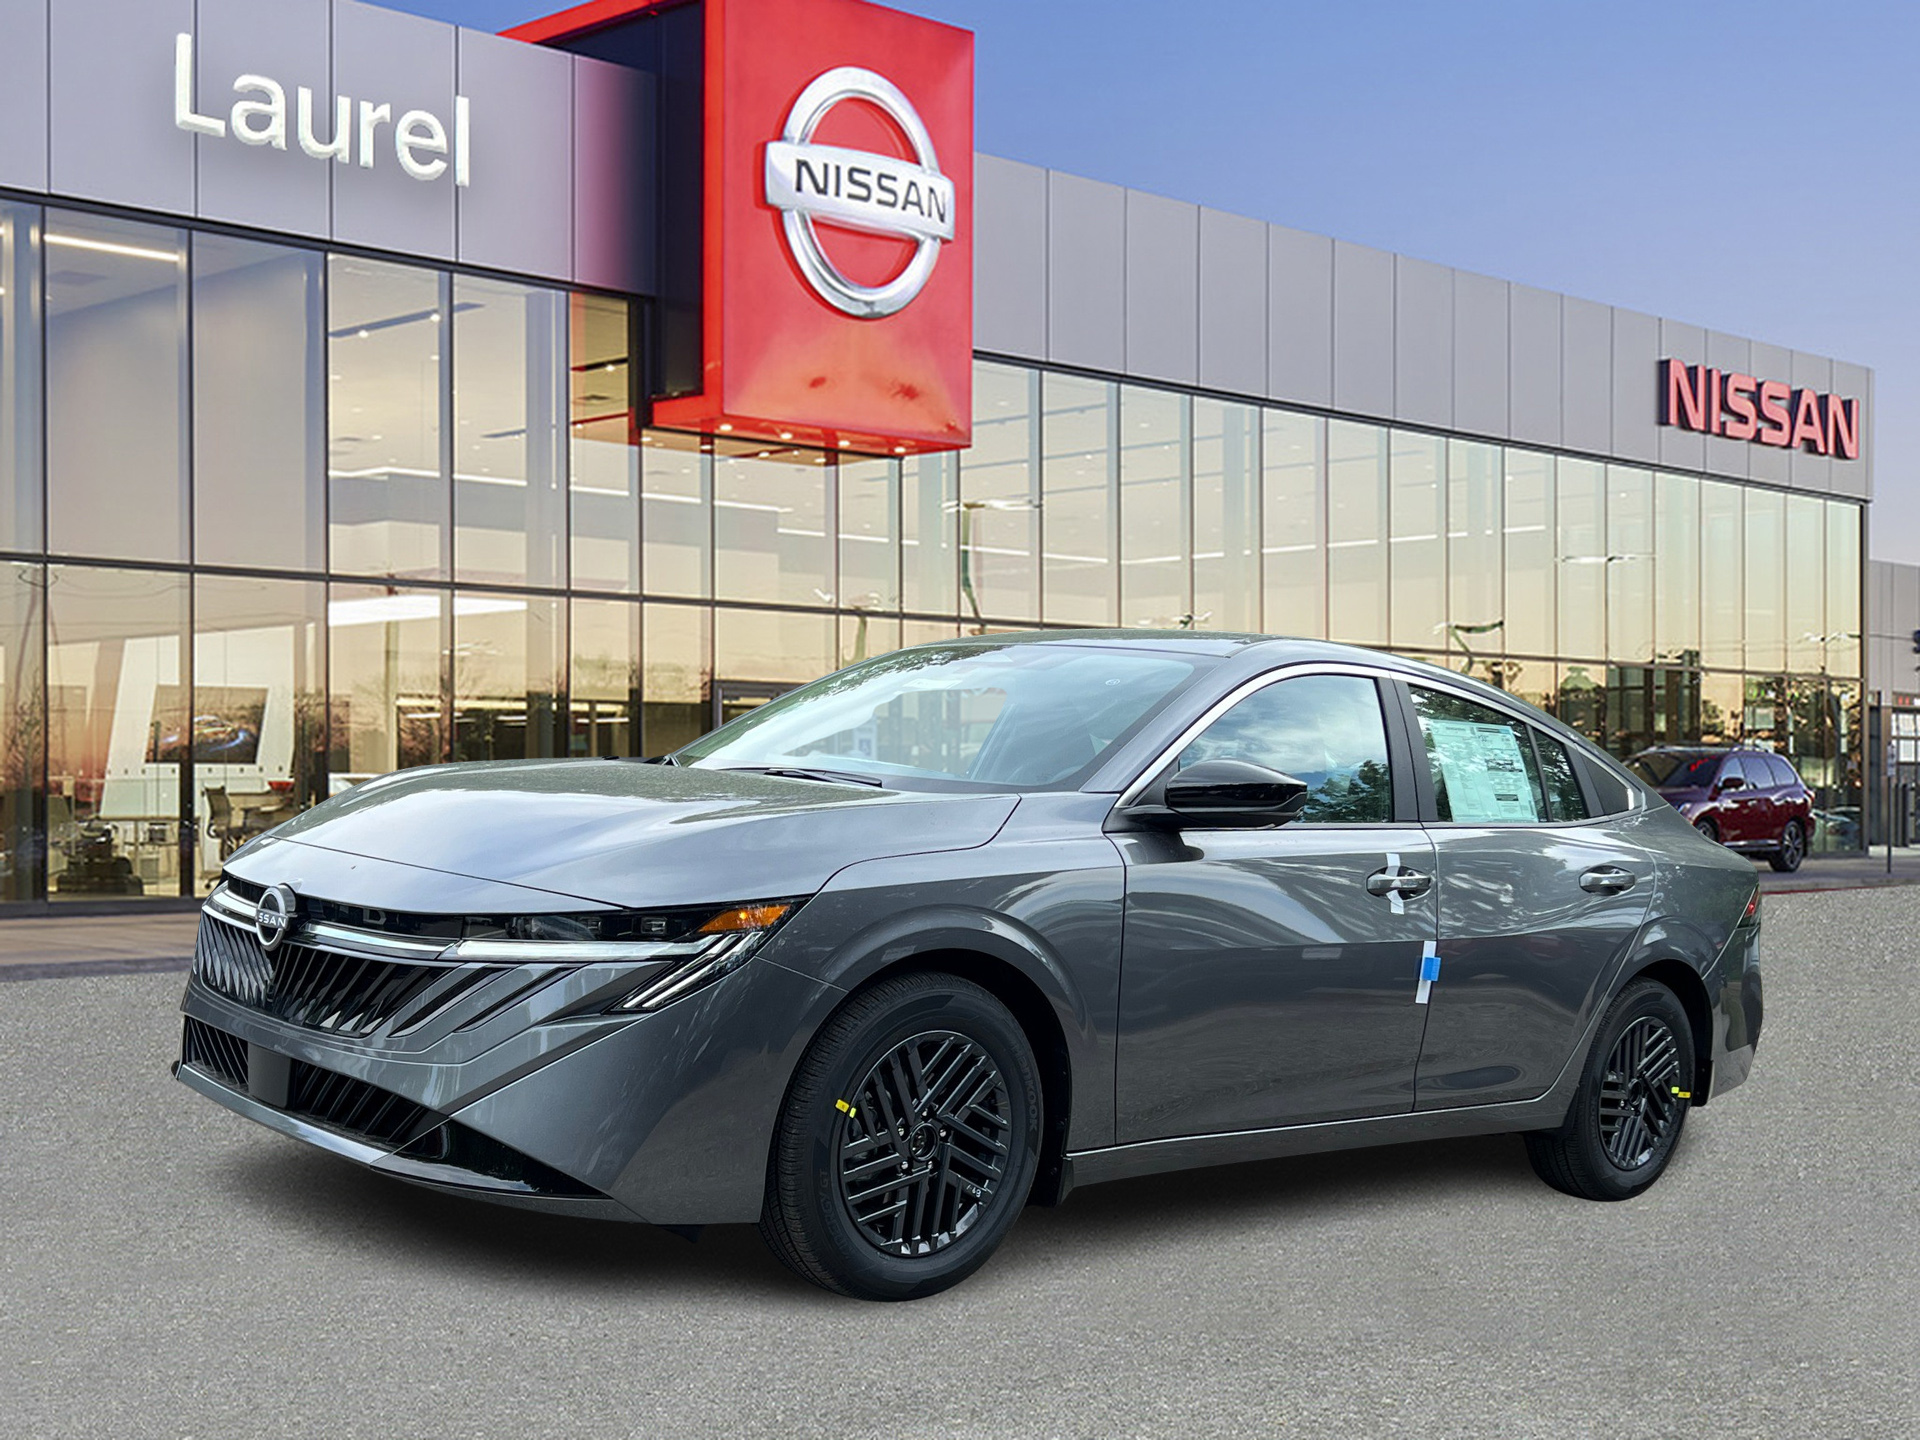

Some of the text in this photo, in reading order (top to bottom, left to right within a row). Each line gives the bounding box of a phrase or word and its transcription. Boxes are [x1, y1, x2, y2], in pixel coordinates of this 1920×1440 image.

[175, 32, 470, 187] Laurel
[796, 159, 947, 223] NISSAN
[1657, 358, 1860, 459] NISSAN
[258, 912, 287, 927] SSAN
